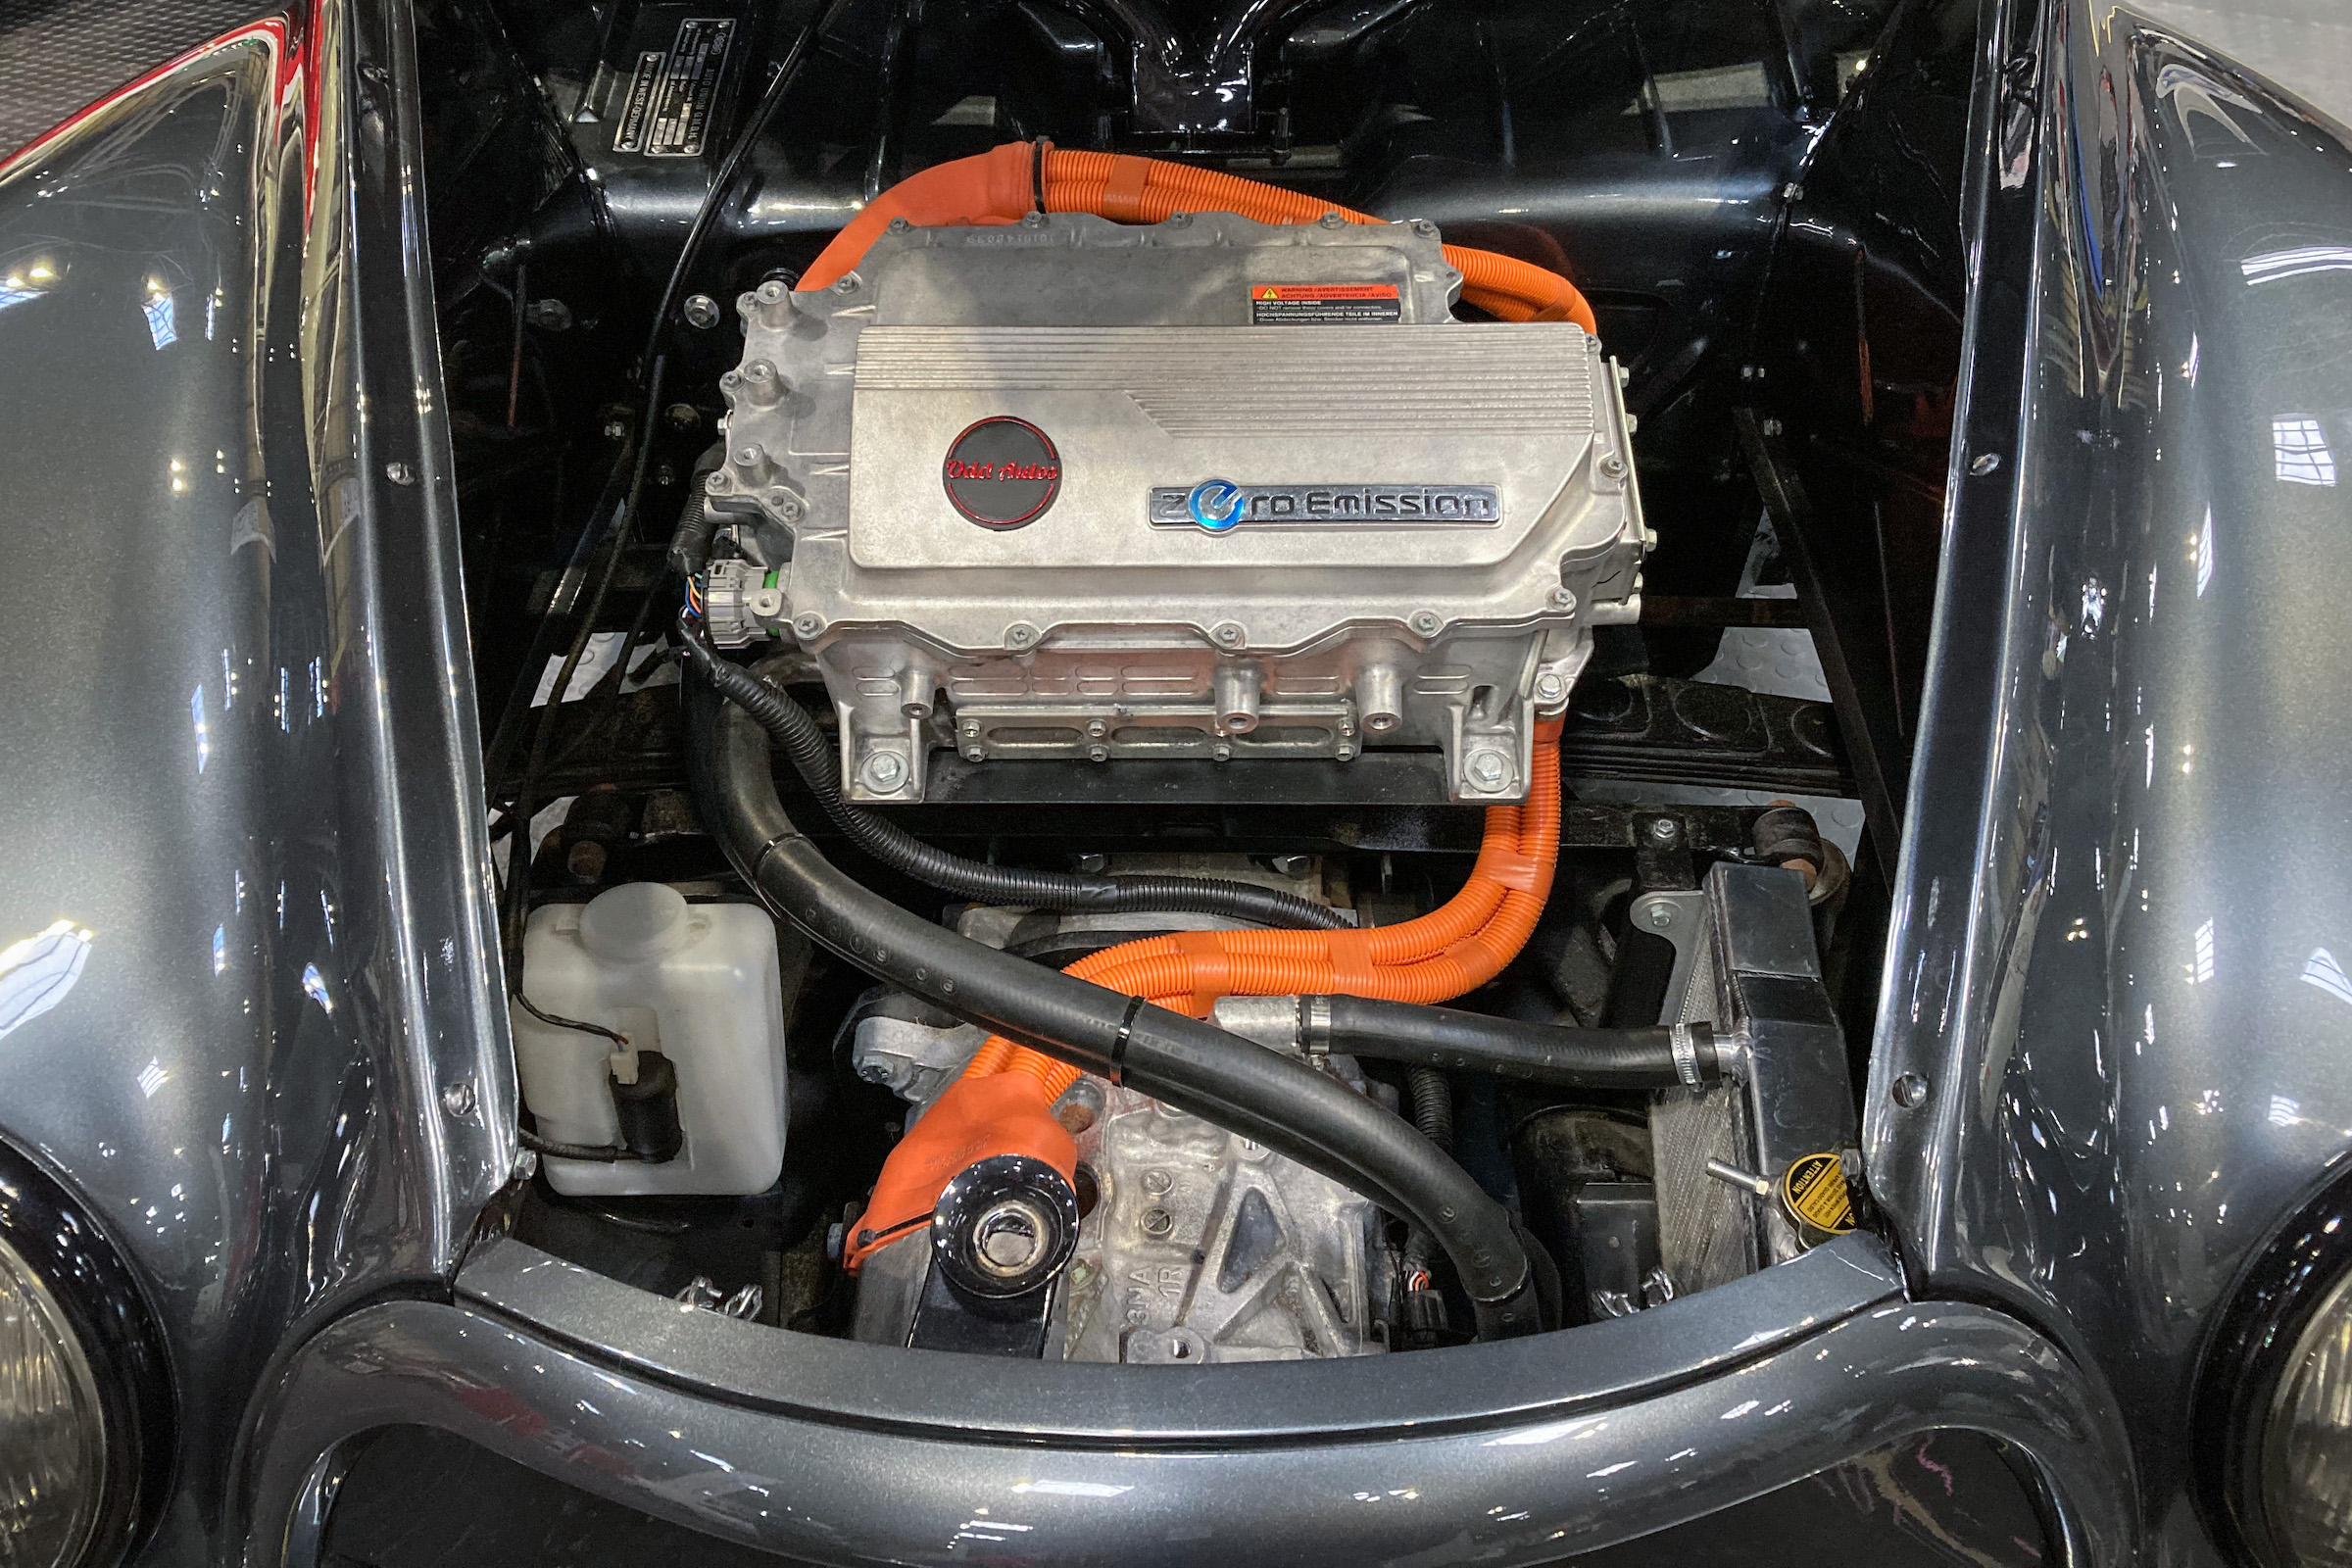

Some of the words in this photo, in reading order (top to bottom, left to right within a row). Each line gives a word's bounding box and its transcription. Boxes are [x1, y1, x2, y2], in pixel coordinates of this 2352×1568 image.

[947, 460, 993, 479] Odd
[998, 460, 1057, 481] Autos
[1305, 489, 1490, 517] Emission
[1791, 1160, 1823, 1194] ATTENTION
